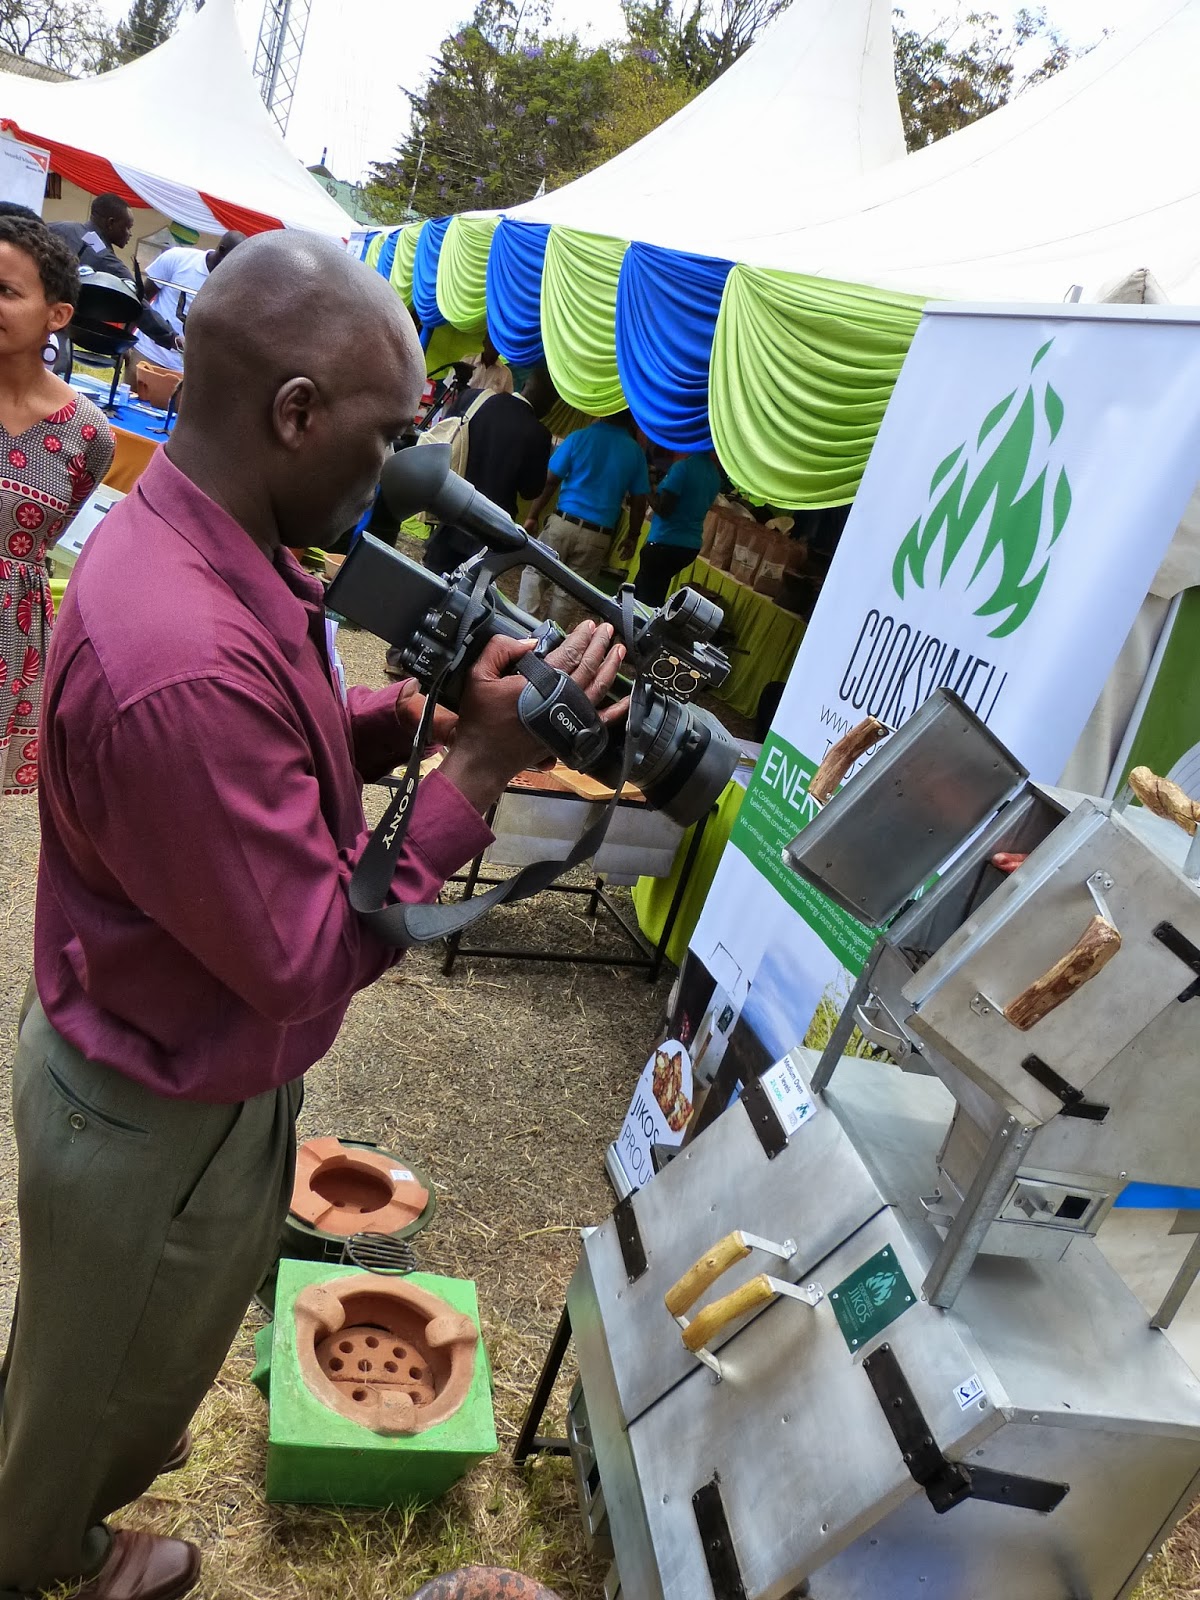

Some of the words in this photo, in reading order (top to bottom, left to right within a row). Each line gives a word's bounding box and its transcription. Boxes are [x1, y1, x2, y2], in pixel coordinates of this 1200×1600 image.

[760, 745, 822, 823] ENER
[382, 777, 415, 850] SONY
[843, 924, 872, 954] manageme
[793, 1077, 805, 1095] Oven
[630, 1094, 660, 1147] JIKOS
[847, 1287, 871, 1323] JIKOS
